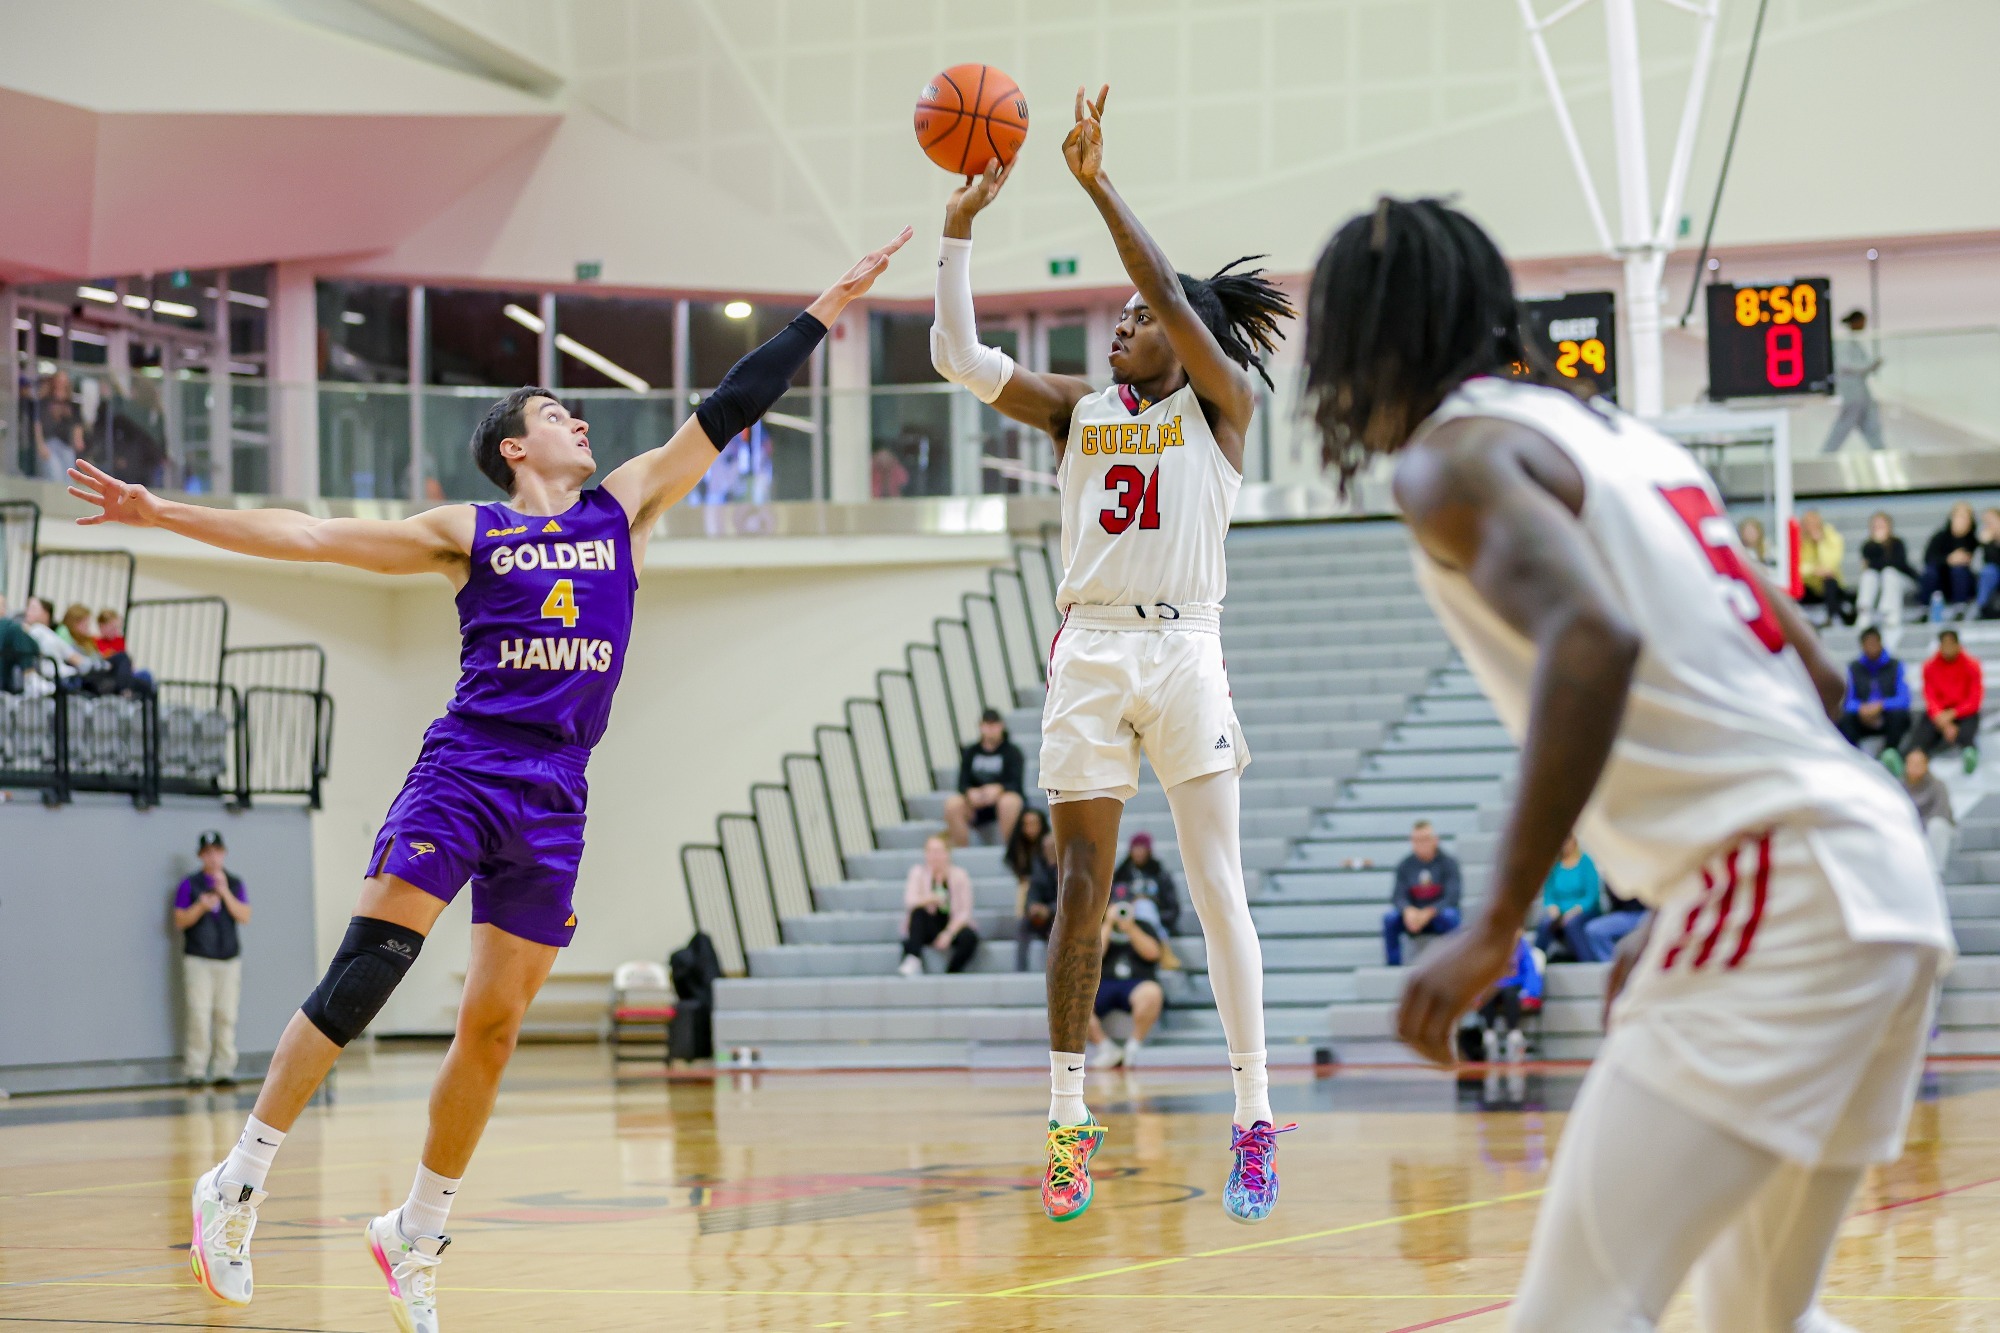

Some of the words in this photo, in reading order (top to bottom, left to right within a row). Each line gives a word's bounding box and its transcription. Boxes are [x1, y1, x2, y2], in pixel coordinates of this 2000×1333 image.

[1735, 284, 1817, 327] 8:50
[1556, 338, 1606, 379] 29
[1765, 323, 1804, 388] 8
[1099, 464, 1161, 535] 31
[490, 538, 616, 576] GOLDEN
[540, 578, 580, 628] 4
[496, 637, 613, 673] HAWKS
